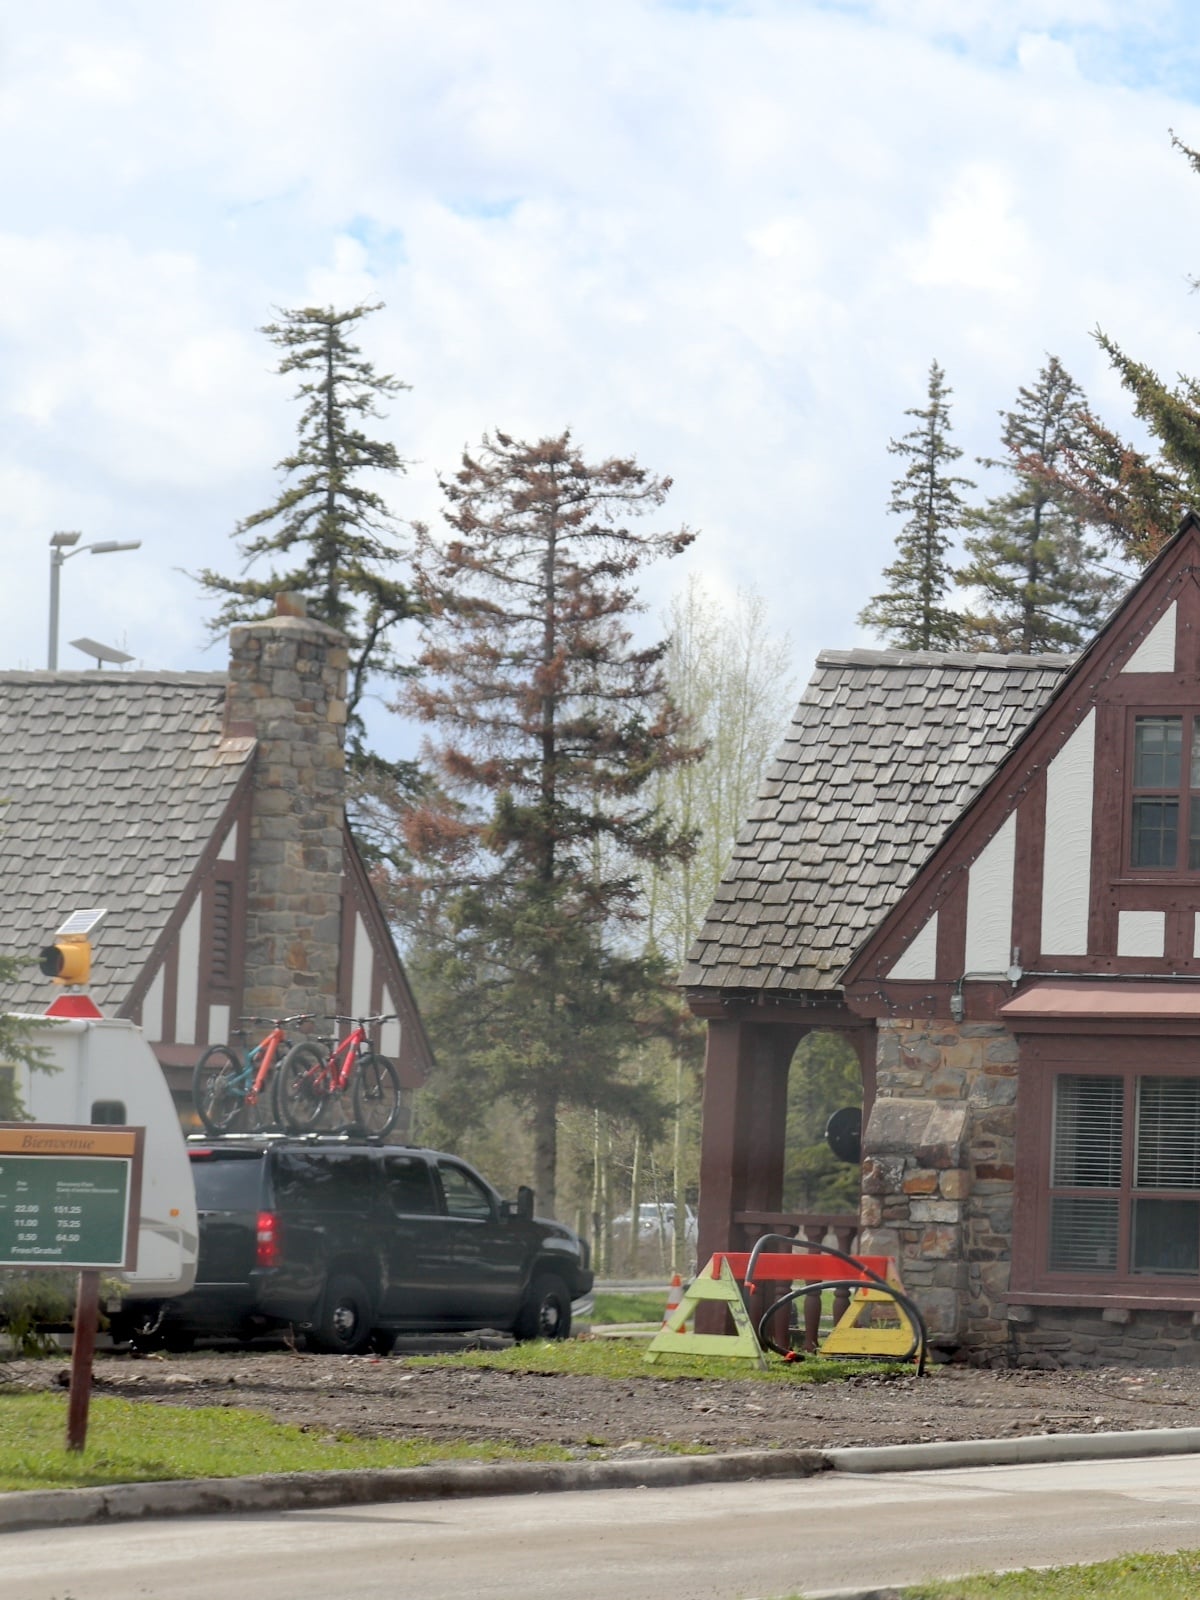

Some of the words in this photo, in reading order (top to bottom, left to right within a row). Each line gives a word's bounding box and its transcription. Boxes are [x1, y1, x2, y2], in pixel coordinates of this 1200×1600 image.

[22, 1135, 95, 1150] Bienvenue
[14, 1205, 39, 1213] 22.00
[54, 1206, 81, 1214] 151.25
[14, 1219, 39, 1227] 11.00
[57, 1220, 81, 1228] 75.25
[18, 1233, 38, 1241] 9.50
[56, 1234, 80, 1242] 64.50
[10, 1246, 63, 1255] Free/Gratuit
